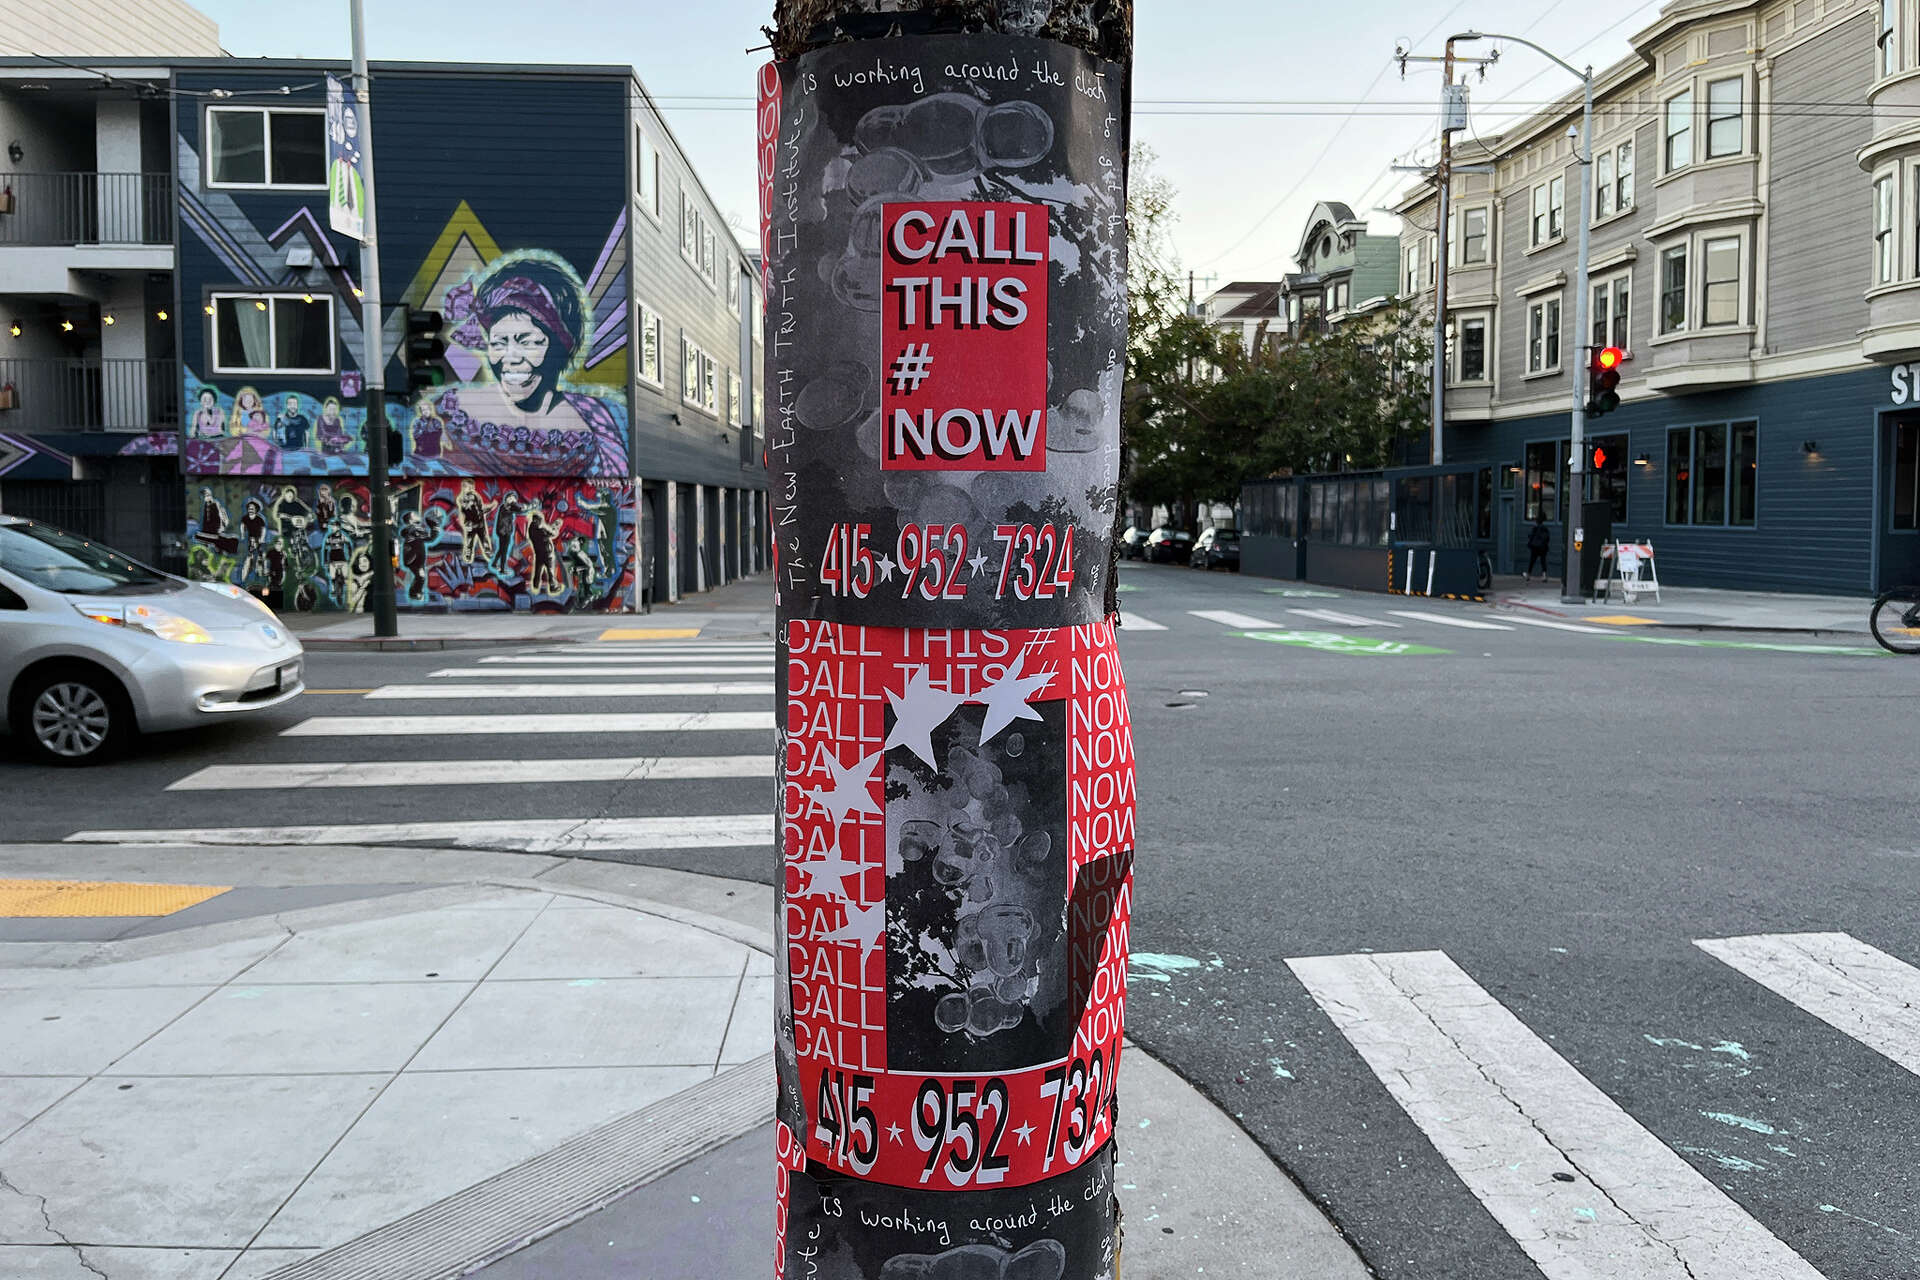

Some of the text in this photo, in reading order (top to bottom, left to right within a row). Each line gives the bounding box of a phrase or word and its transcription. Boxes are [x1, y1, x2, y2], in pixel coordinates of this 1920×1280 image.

[802, 72, 818, 95] is
[834, 58, 925, 94] working
[945, 57, 1019, 81] around
[1032, 60, 1065, 86] the
[777, 108, 804, 255] Institute
[1098, 155, 1122, 193] gt
[887, 209, 1043, 264] CALL
[1107, 211, 1122, 240] the
[887, 276, 1029, 329] THIS
[886, 343, 934, 395] #
[889, 408, 1042, 460] NOW
[788, 537, 806, 591] The
[820, 523, 1075, 600] 415 952 7324
[789, 619, 882, 657] CALL
[788, 659, 882, 700] CALL
[1072, 650, 1126, 695] NOW
[787, 700, 882, 742] CALL
[1072, 689, 1131, 736] NOW
[1072, 726, 1135, 775] NOW
[1072, 768, 1137, 817] NOW
[784, 823, 883, 868] CAL
[1071, 806, 1136, 857] NOW
[788, 942, 884, 992] CALL
[791, 979, 884, 1031] CALL
[794, 1019, 885, 1073] CALL
[814, 1066, 879, 1176] 415
[911, 1077, 1010, 1187] 952
[861, 1208, 951, 1246] working
[970, 1204, 1038, 1231] around
[1047, 1195, 1075, 1217] the
